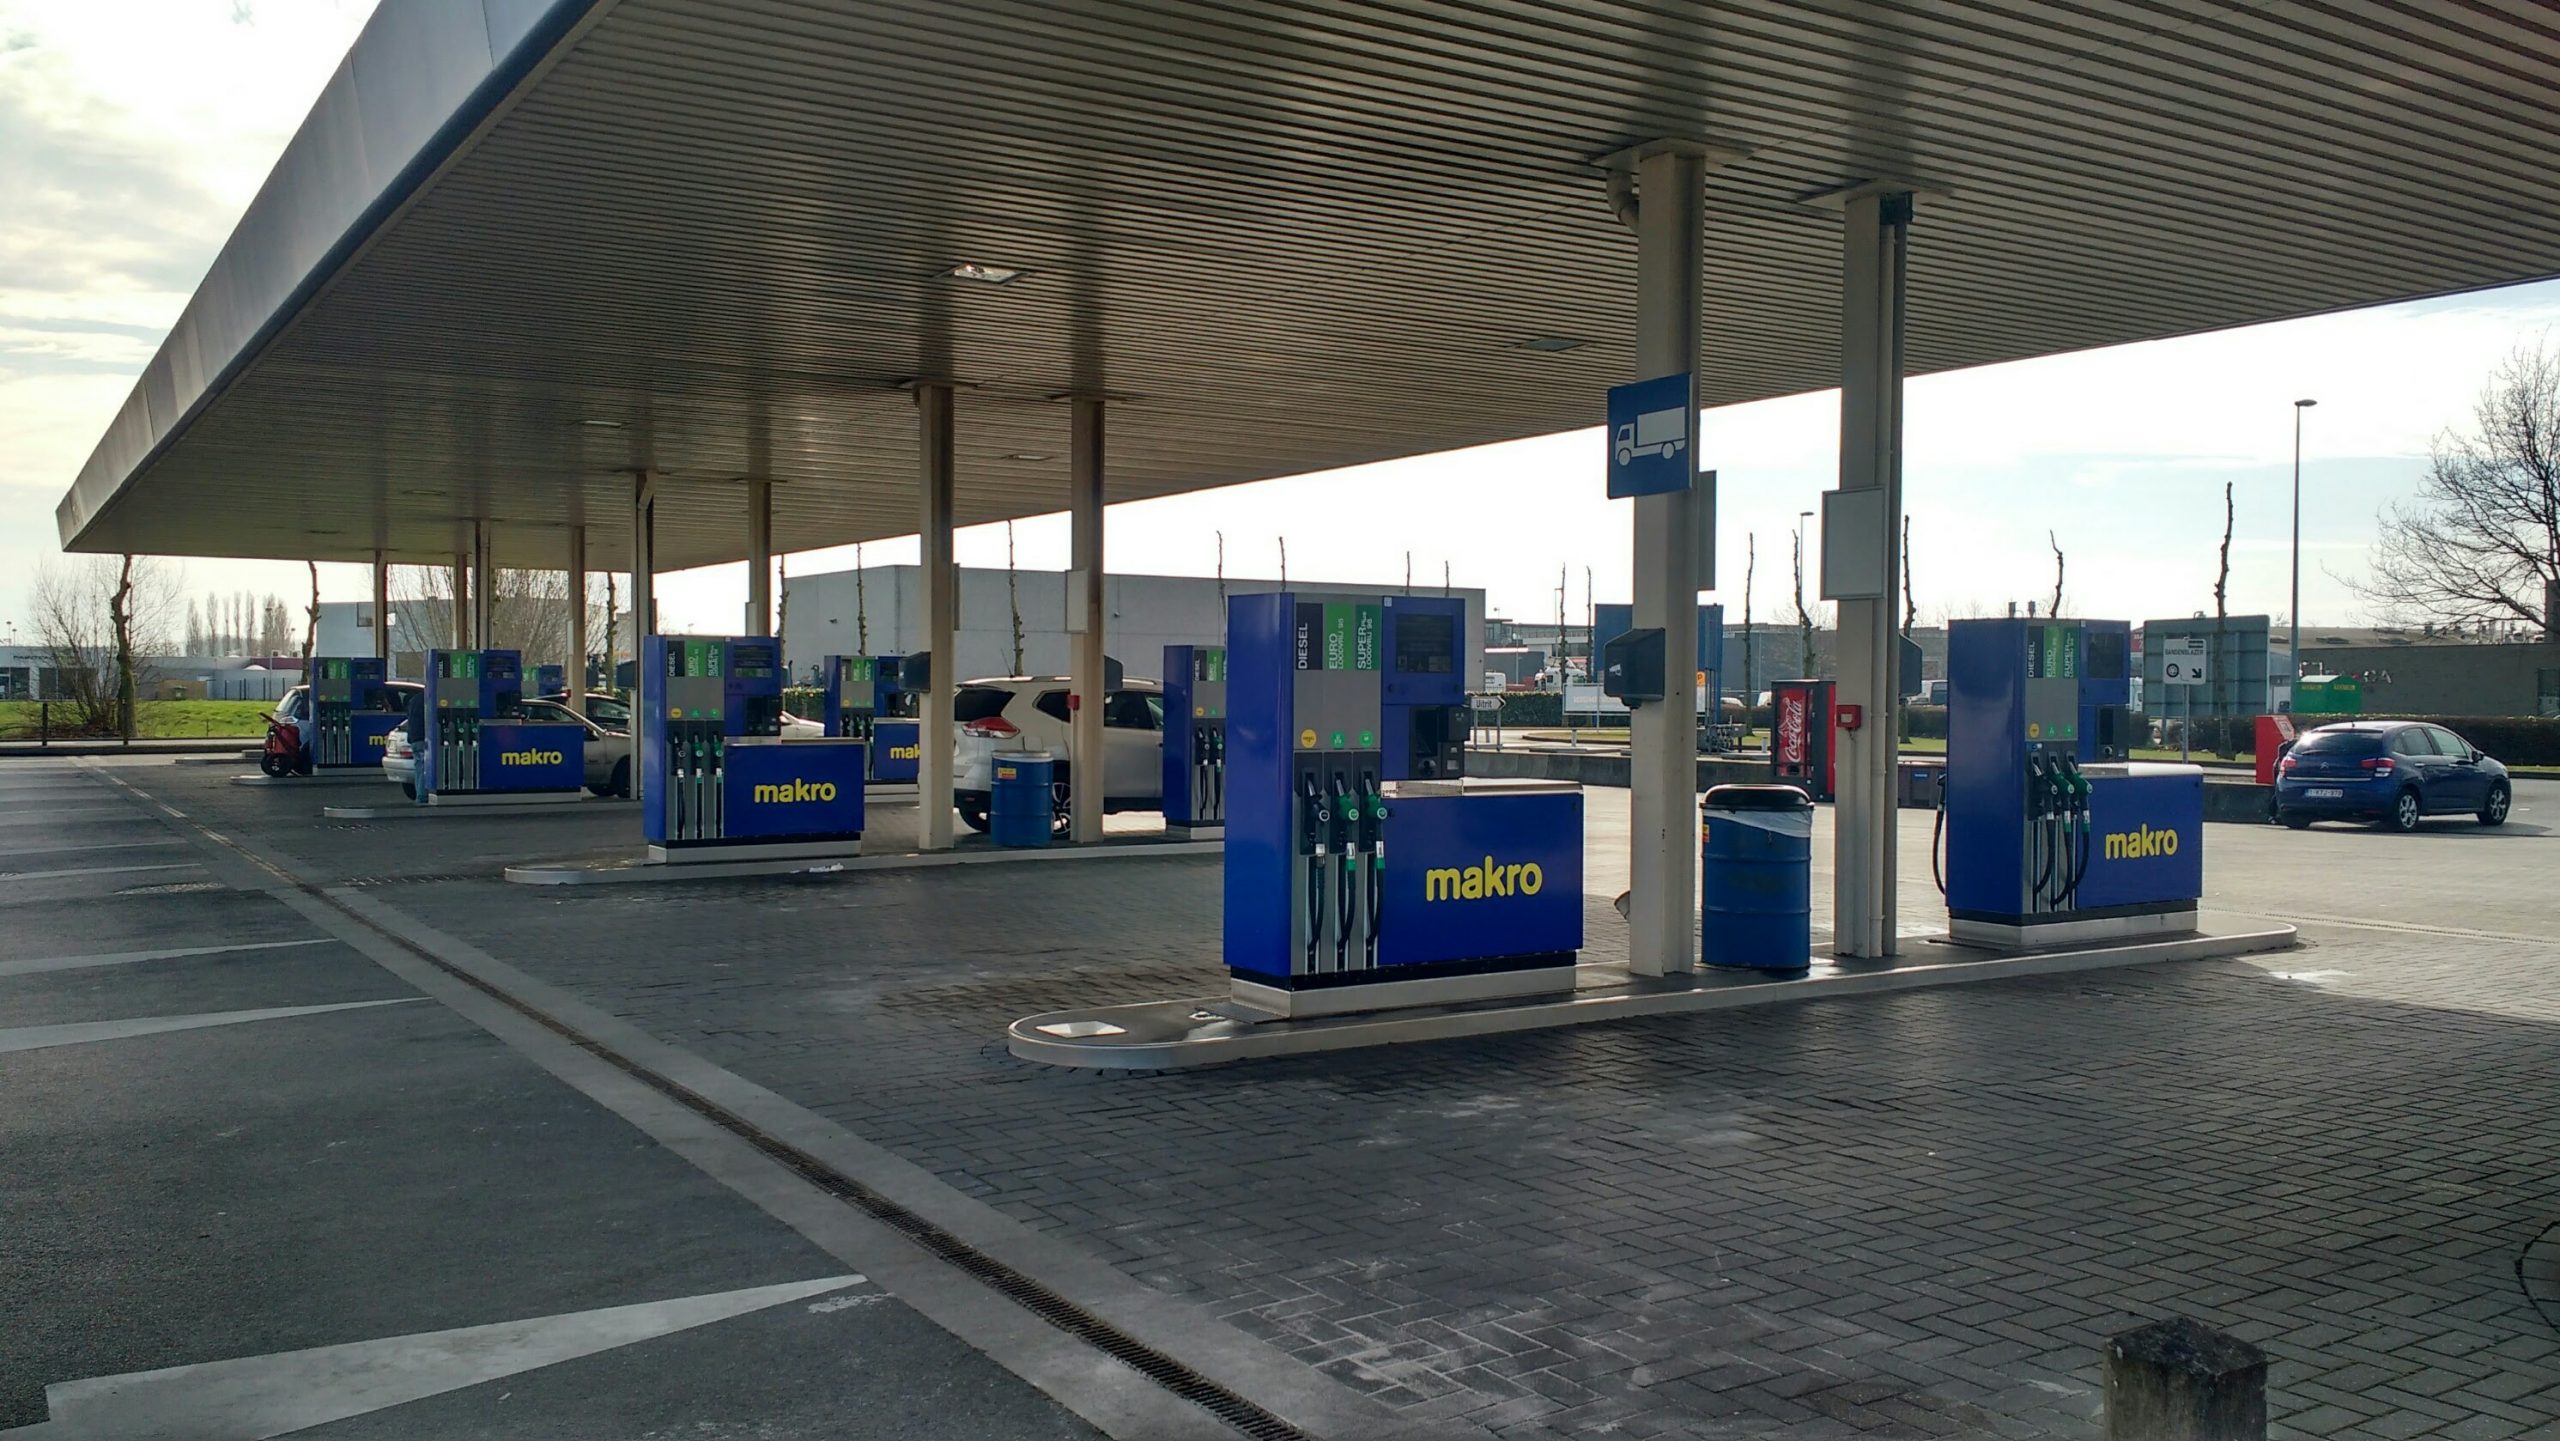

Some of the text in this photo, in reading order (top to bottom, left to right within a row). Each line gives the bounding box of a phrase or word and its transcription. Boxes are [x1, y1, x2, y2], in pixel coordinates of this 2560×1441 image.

[1298, 622, 1308, 669] DIESEL
[1329, 633, 1338, 669] EURO
[1358, 627, 1367, 669] SUPER
[501, 747, 562, 766] makro
[890, 743, 920, 759] mak
[754, 778, 837, 803] makro
[2105, 824, 2178, 859] makro
[1425, 855, 1543, 902] makro
